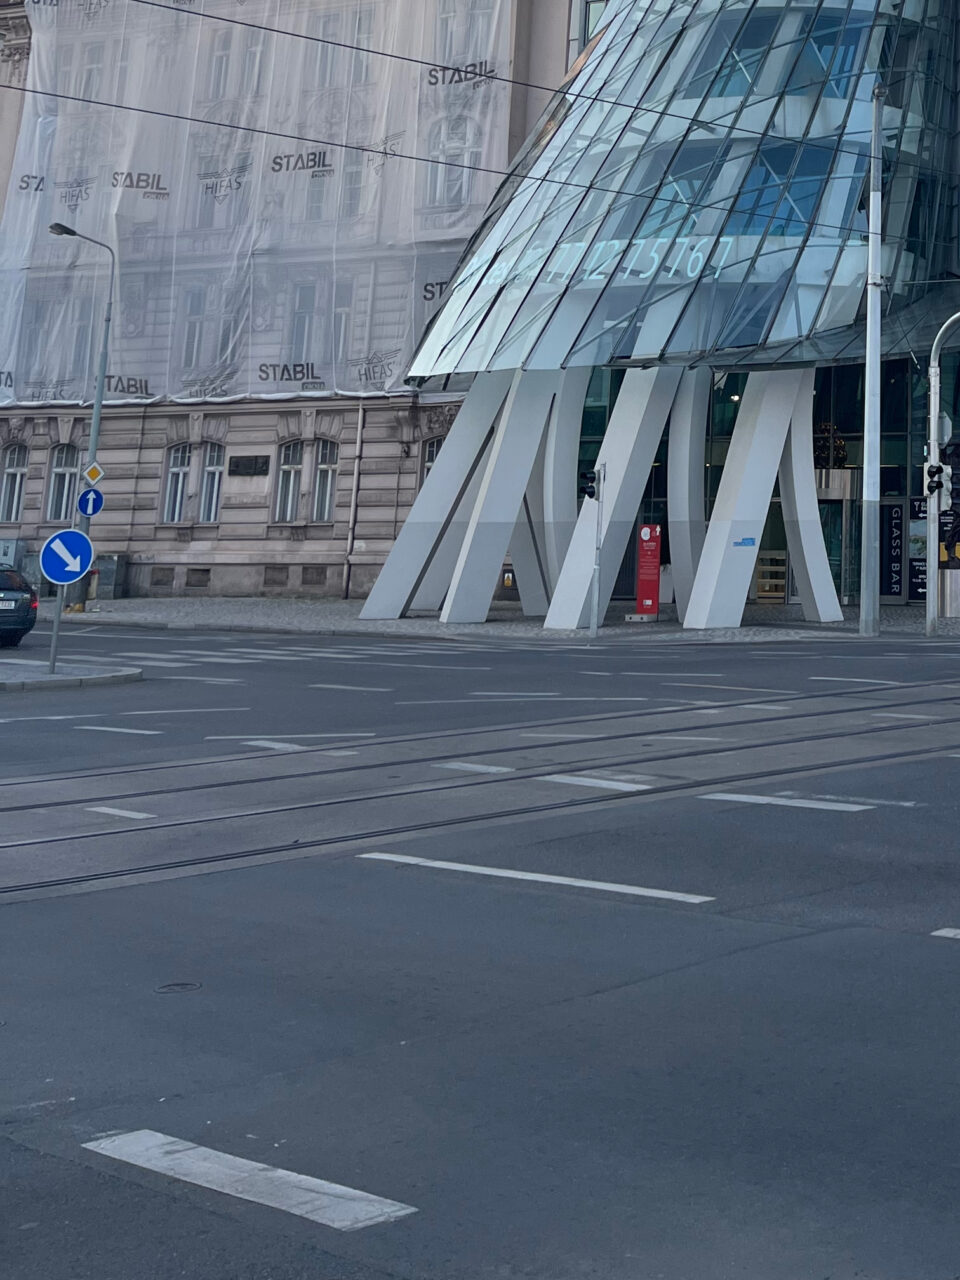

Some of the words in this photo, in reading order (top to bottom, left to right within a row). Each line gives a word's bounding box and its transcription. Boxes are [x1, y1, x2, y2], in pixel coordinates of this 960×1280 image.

[428, 60, 497, 86] STABIL
[271, 151, 332, 173] STABIL
[112, 171, 167, 191] STABIL
[205, 175, 242, 195] HIFAS
[60, 187, 90, 203] HIFAS
[258, 363, 320, 382] STABIL
[358, 363, 394, 382] HIFAS
[891, 507, 901, 555] GLASS
[891, 563, 900, 593] BAR
